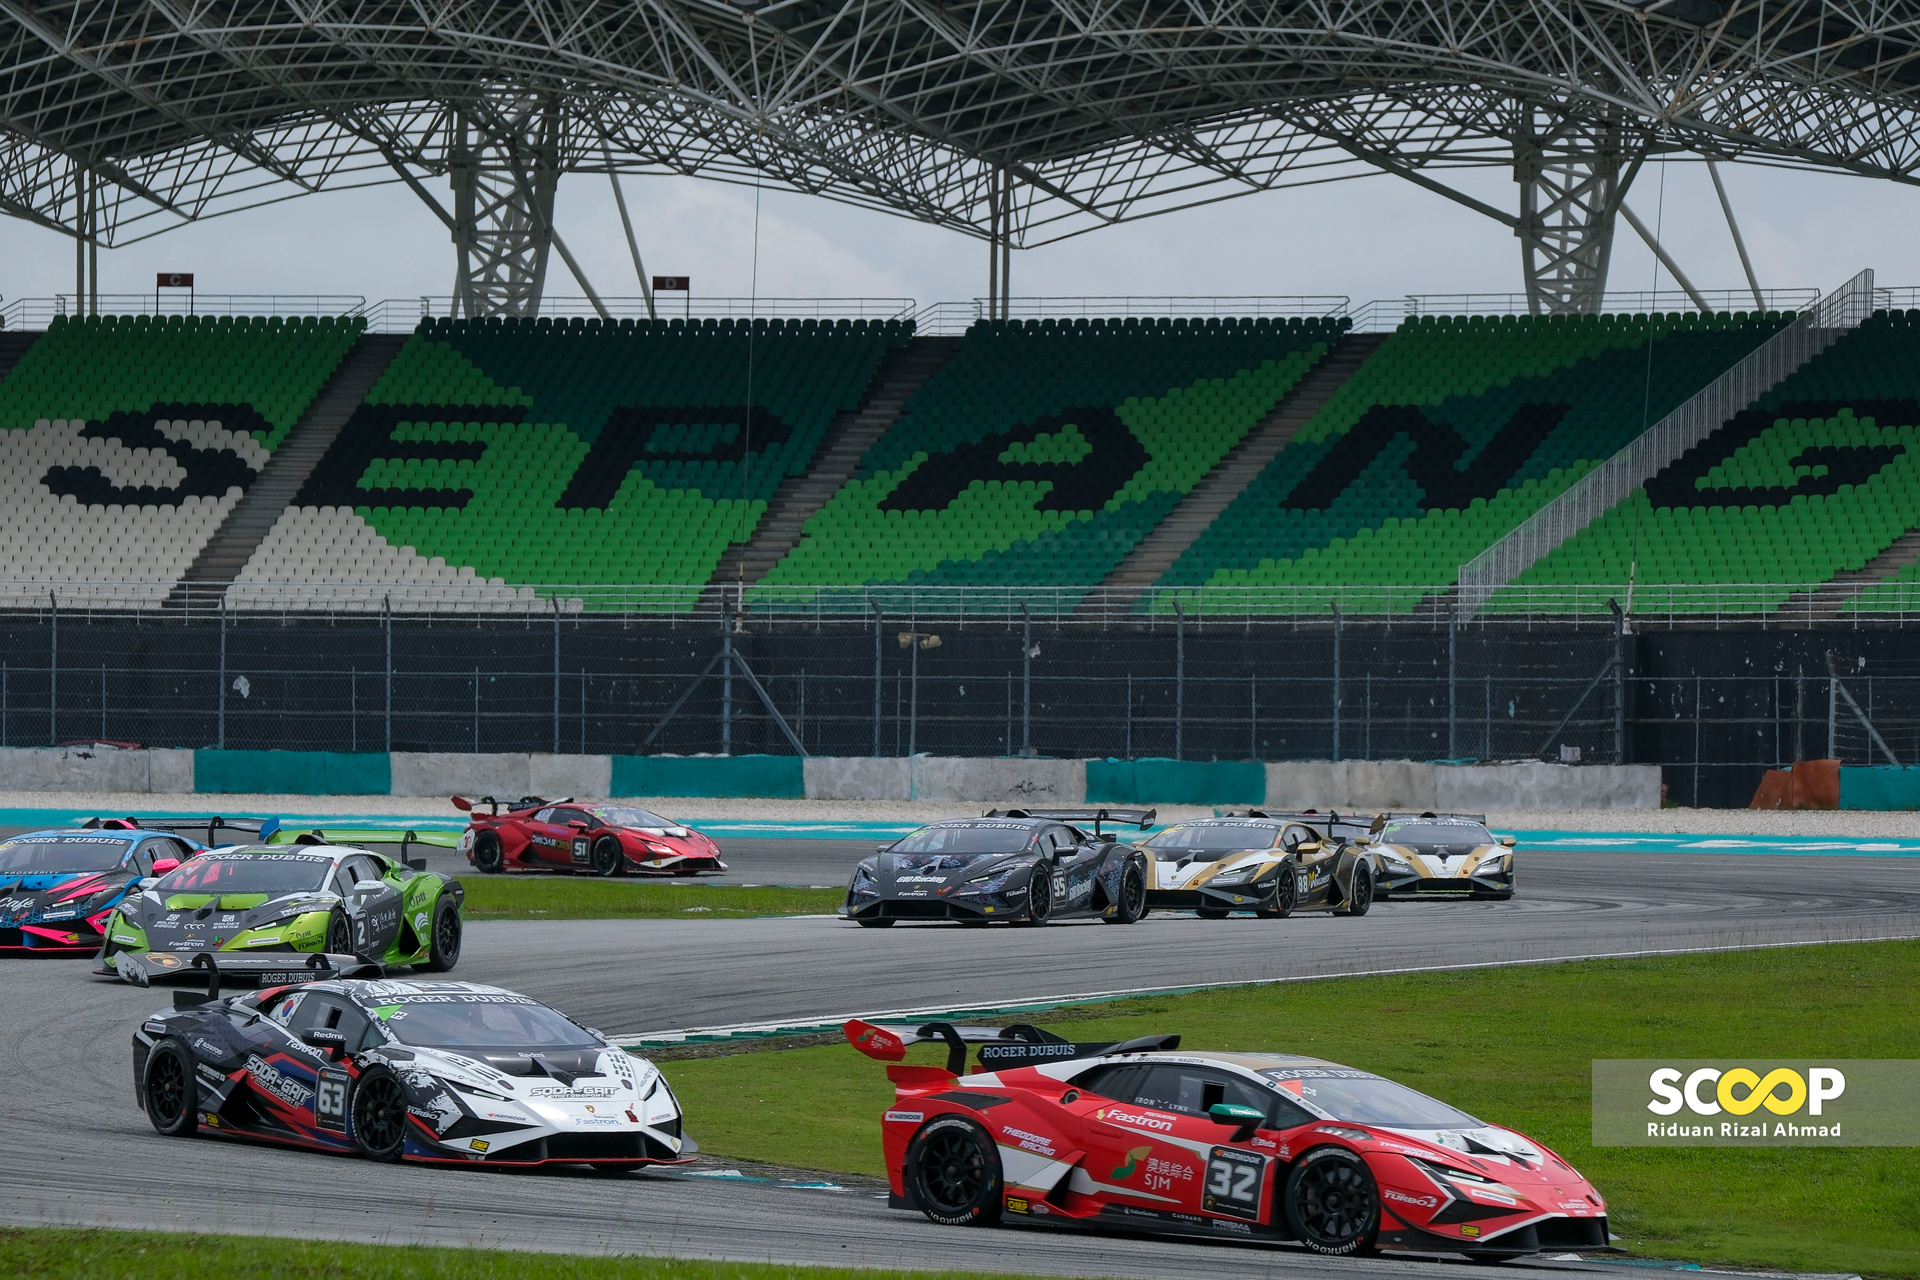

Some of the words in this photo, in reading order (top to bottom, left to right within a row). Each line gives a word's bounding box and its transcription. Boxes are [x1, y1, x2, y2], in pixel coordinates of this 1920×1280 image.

[170, 274, 181, 286] C
[665, 278, 677, 289] D
[41, 400, 1919, 508] SEPANG
[974, 823, 1031, 831] DUBUIS
[62, 837, 126, 845] DUBUIS
[574, 841, 586, 856] 51
[197, 853, 253, 862] ROGER
[258, 853, 326, 863] DUBUIS
[1053, 877, 1066, 898] 95
[1297, 875, 1308, 893] 88
[357, 921, 366, 946] 2
[261, 973, 287, 984] ROGER
[288, 971, 316, 982] DUBUIS
[375, 995, 457, 1005] ROGER
[460, 995, 537, 1006] DUBUIS
[313, 1031, 343, 1040] Redmi
[983, 1047, 1027, 1059] ROGER
[1029, 1045, 1076, 1058] DUBUIS
[318, 1081, 345, 1116] 63
[1134, 1096, 1155, 1106] IRON
[1168, 1102, 1189, 1113] LYNX
[406, 1105, 438, 1120] TURBO
[576, 1118, 619, 1126] Fastron
[1106, 1109, 1173, 1132] Fastron
[1002, 1125, 1052, 1147] THEODORE
[471, 1139, 488, 1151] OMP
[1019, 1140, 1056, 1156] RACING
[1379, 1141, 1436, 1156] THEODORE
[1144, 1173, 1171, 1190] SJM
[1207, 1160, 1258, 1201] 32
[1008, 1200, 1028, 1212] OMP
[1212, 1219, 1250, 1231] PRISMA
